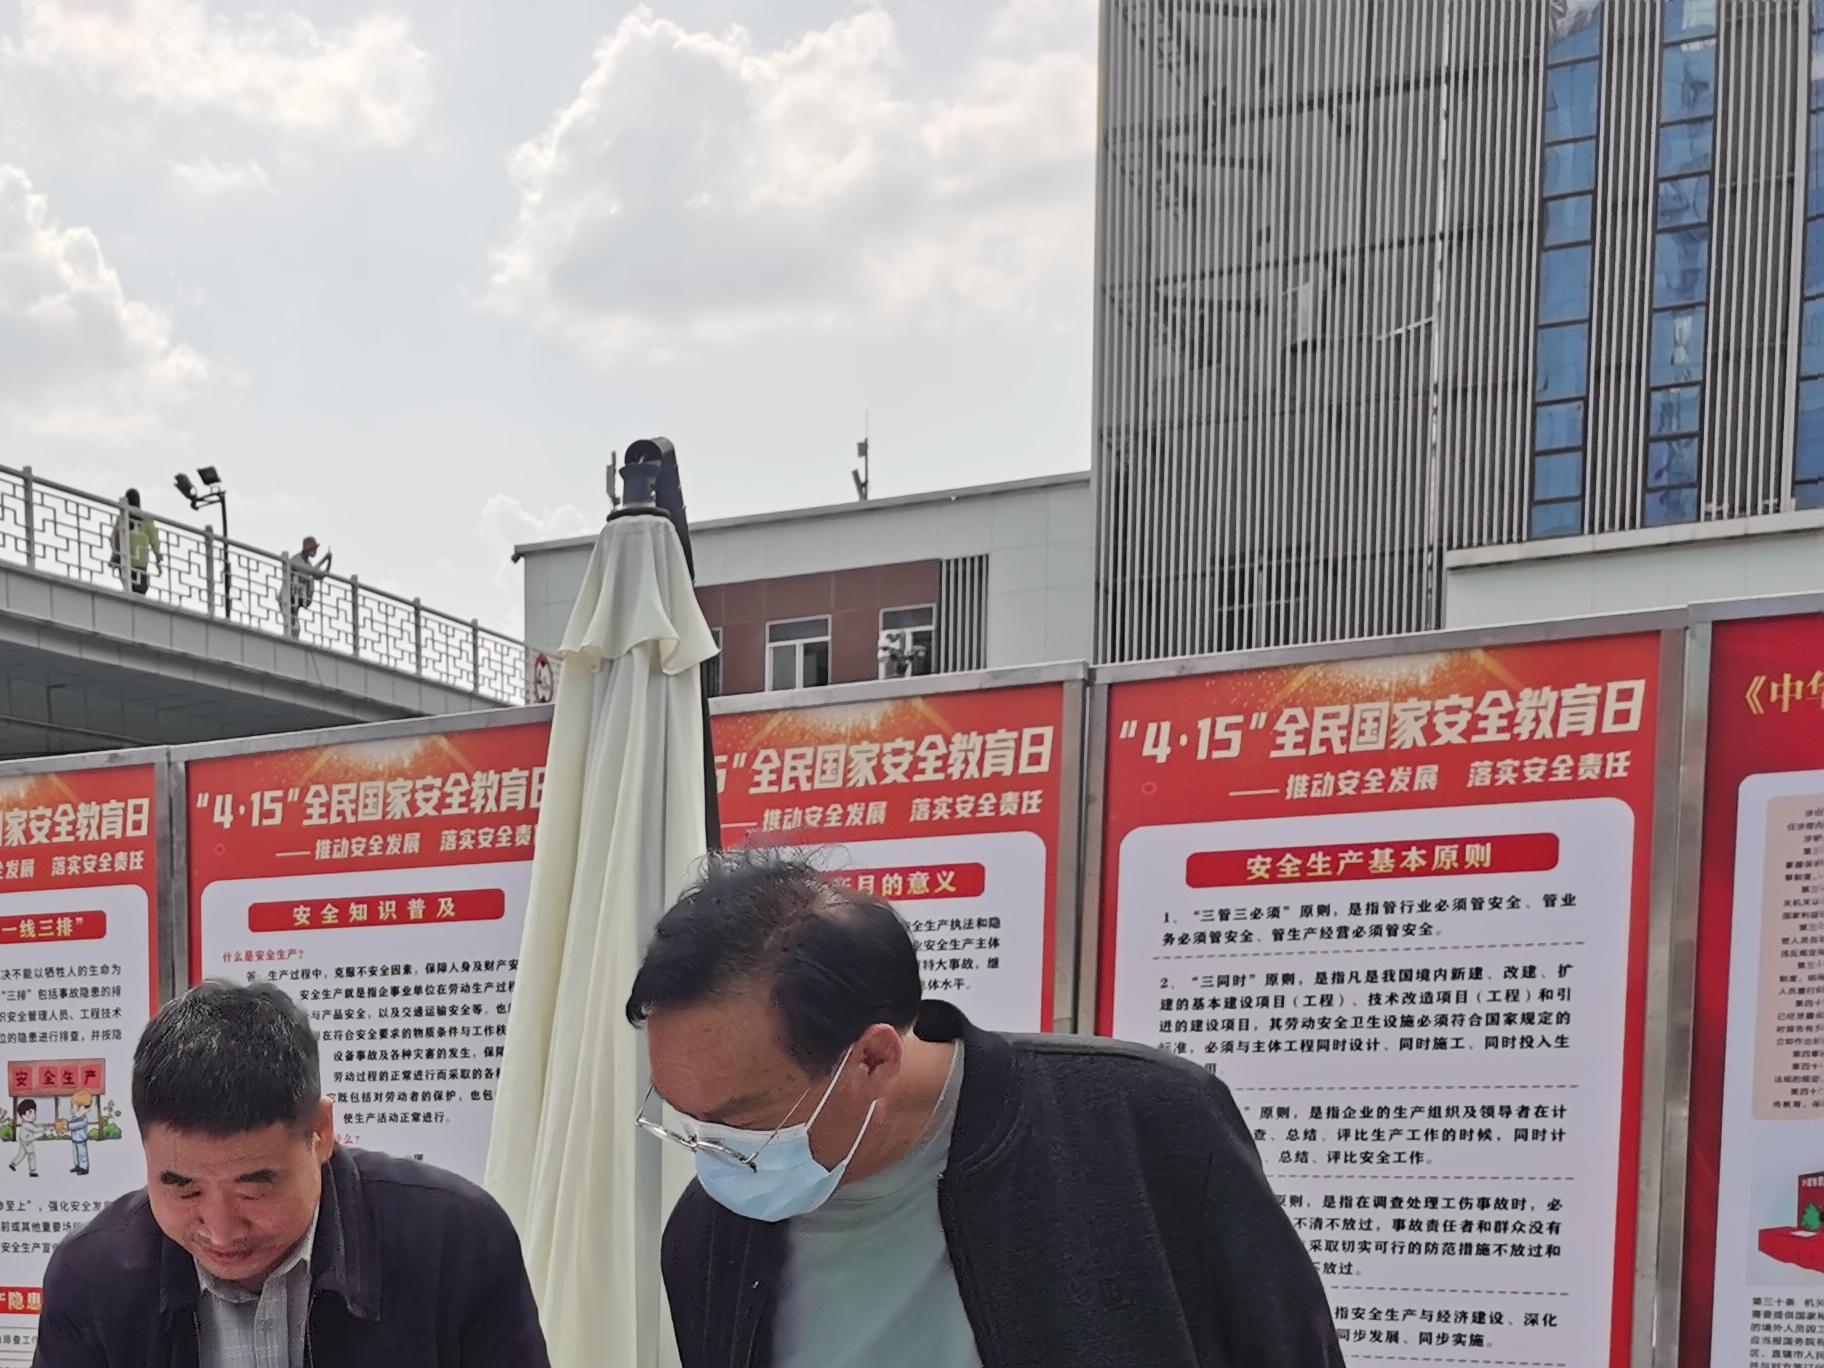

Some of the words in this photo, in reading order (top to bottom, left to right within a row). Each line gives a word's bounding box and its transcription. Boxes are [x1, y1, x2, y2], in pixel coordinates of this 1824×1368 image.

[1467, 750, 1632, 787] 落实安全责任
[909, 789, 1044, 823] 落实安全责任
[51, 850, 145, 877] 落实安全责任
[1245, 842, 1492, 881] 安全生产基本原则
[292, 896, 456, 928] 安全知识普及
[907, 917, 1001, 932] 全生产执法和隐
[1161, 921, 1444, 948] 务必须管安全、管生产经营必须管安全。
[1159, 1009, 1572, 1034] 进的建设项目,其劳动安全卫生设施必须符合国家规定的
[14, 1069, 97, 1088] 安全生产
[344, 1111, 451, 1125] 使生产活动正常进行。
